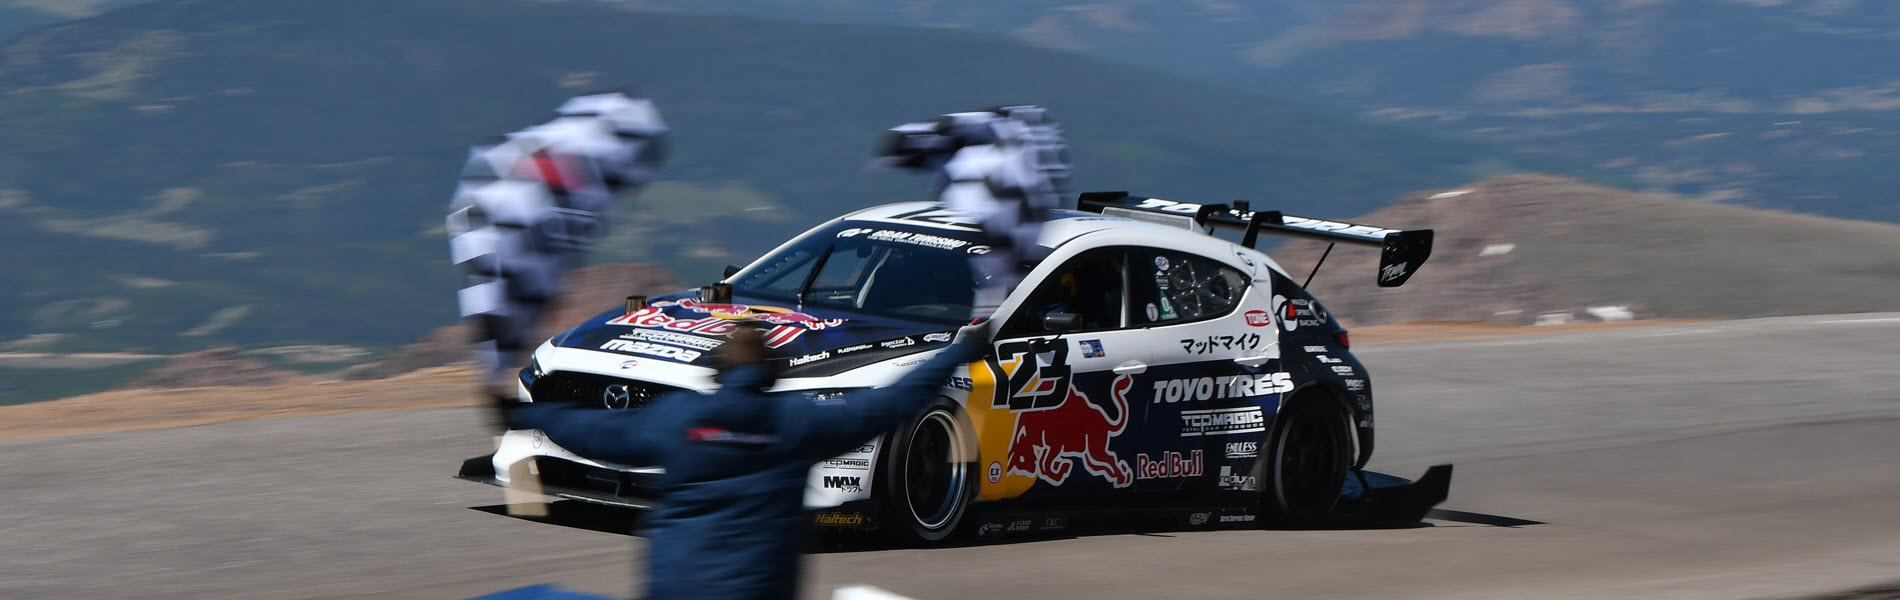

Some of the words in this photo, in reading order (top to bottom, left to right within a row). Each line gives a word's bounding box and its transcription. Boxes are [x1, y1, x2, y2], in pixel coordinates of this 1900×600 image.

[1180, 333, 1261, 355] マッドマイク
[789, 351, 830, 367] Haltech
[984, 338, 1071, 411] 123
[944, 376, 974, 392] RES
[1153, 377, 1214, 404] TOYO
[1215, 372, 1295, 399] TIRES
[823, 476, 862, 488] MAX
[815, 513, 862, 524] Haltech
